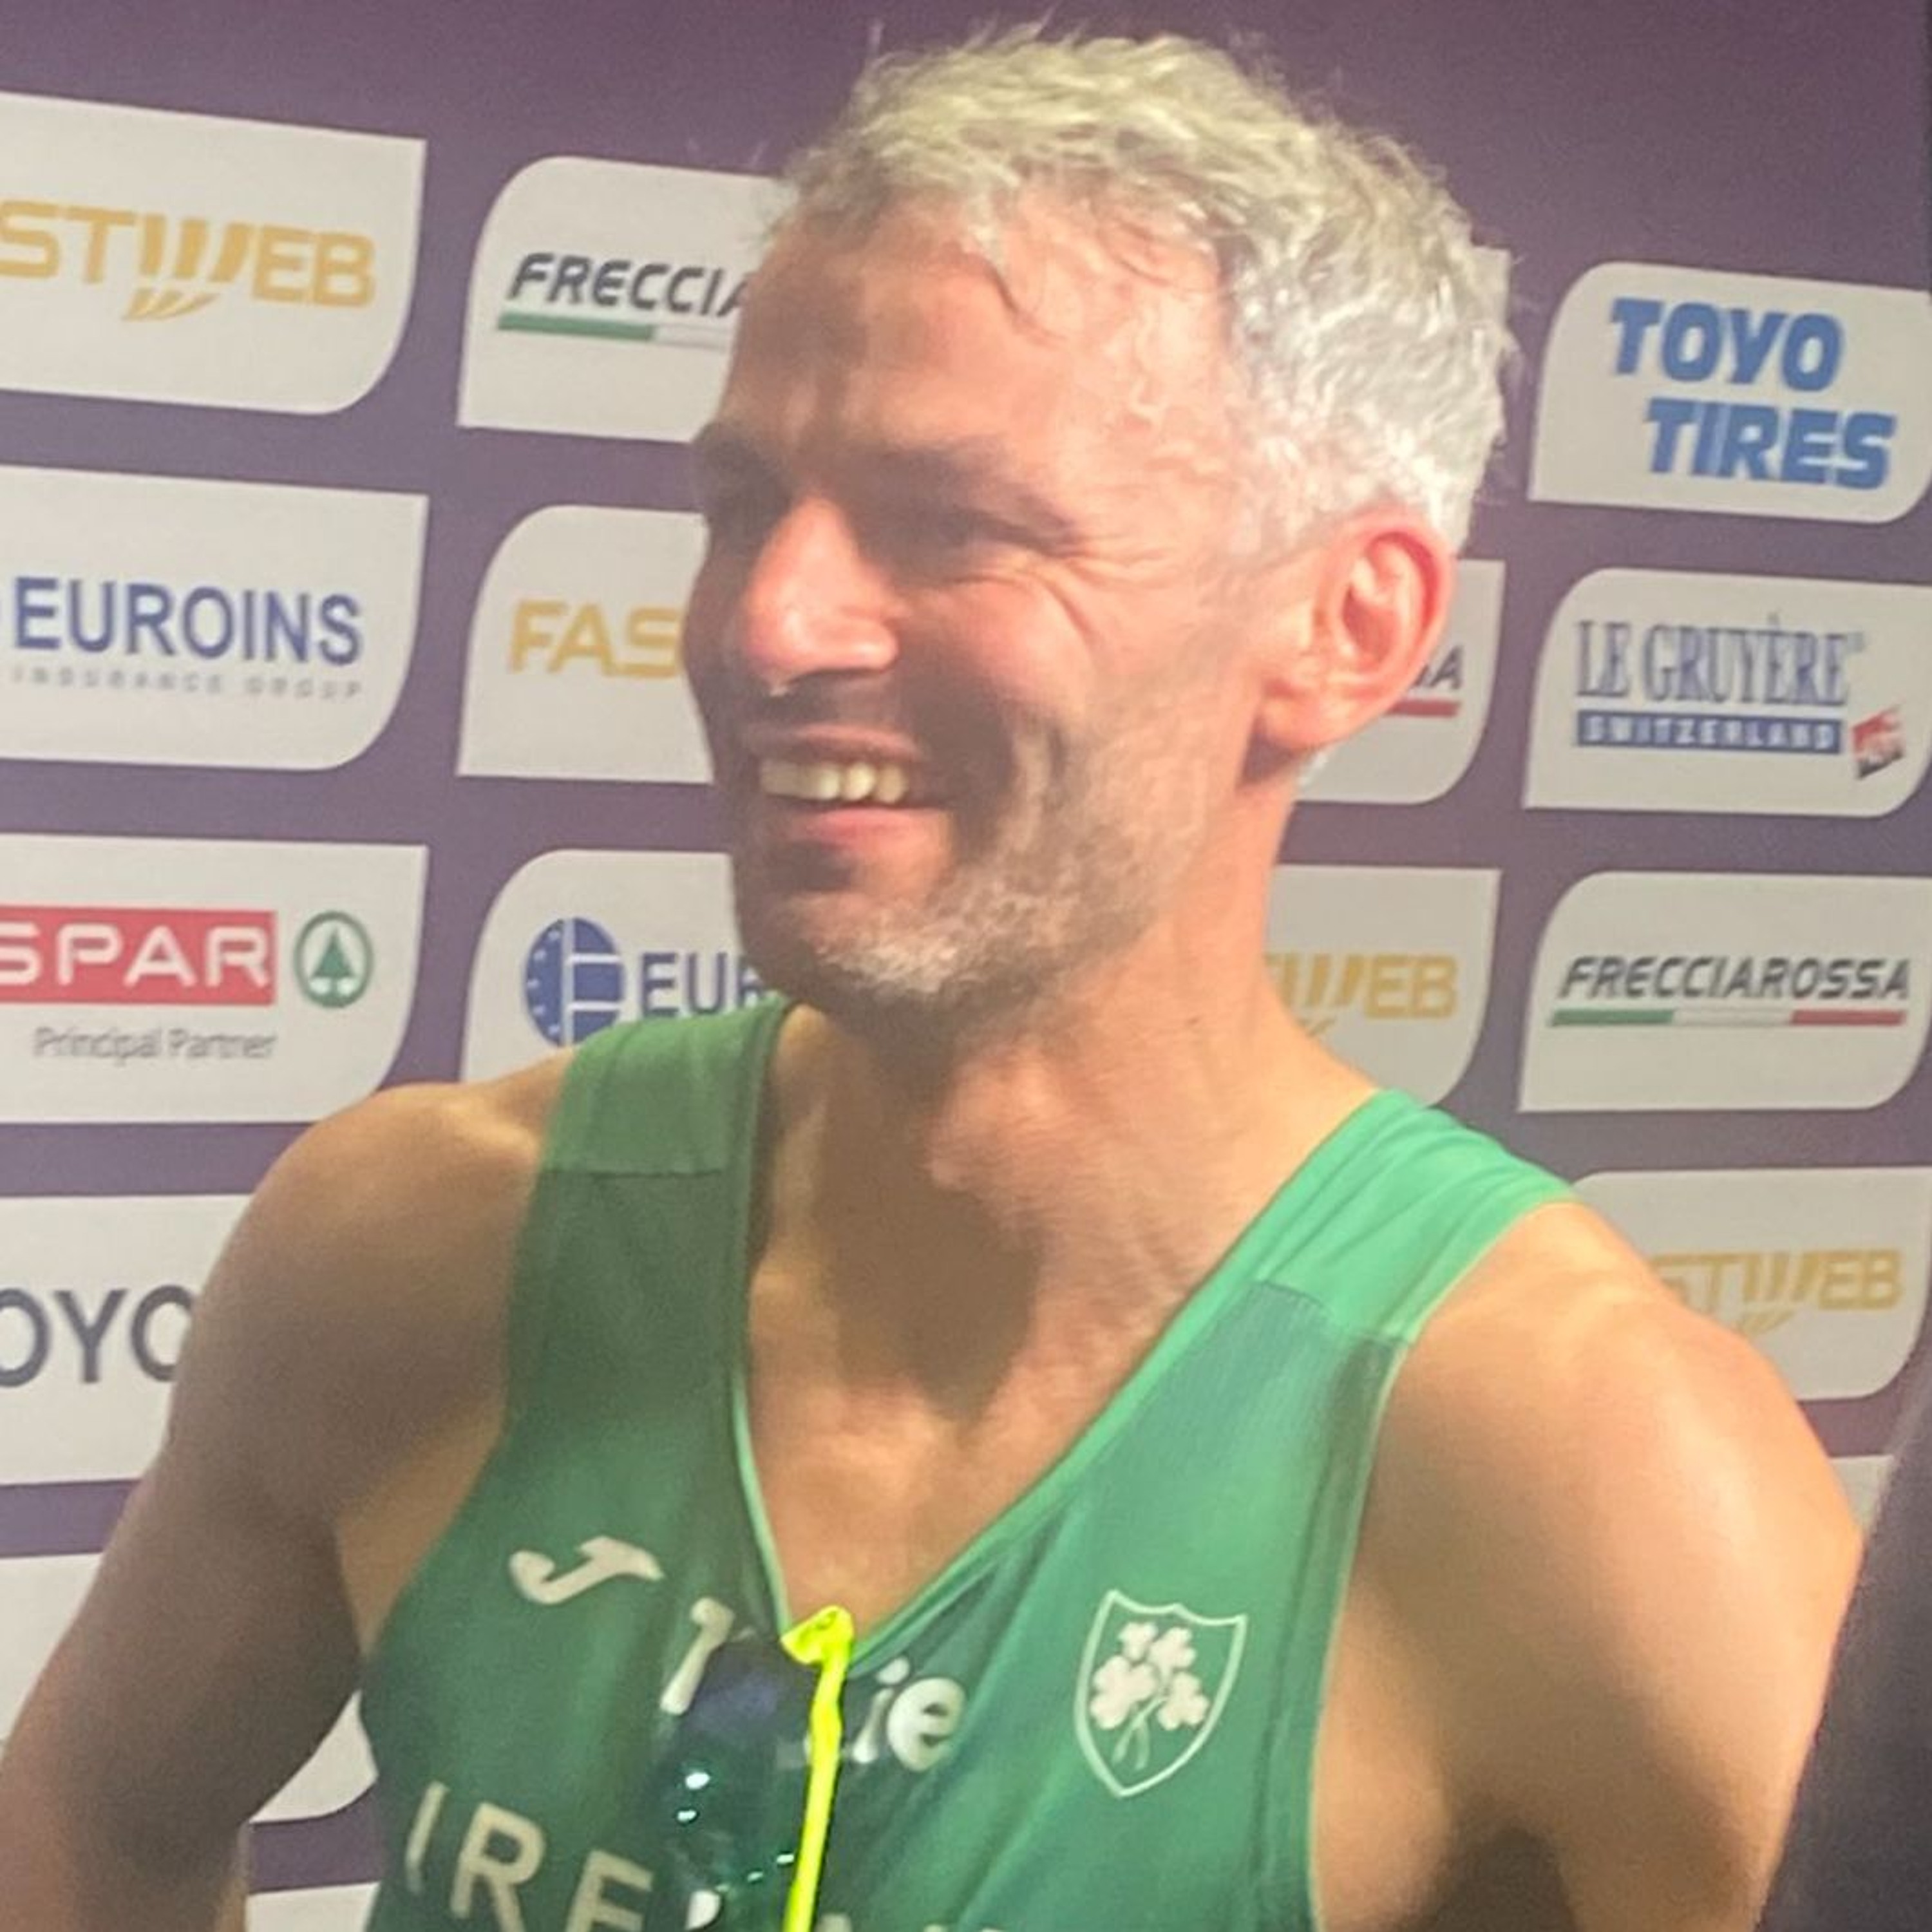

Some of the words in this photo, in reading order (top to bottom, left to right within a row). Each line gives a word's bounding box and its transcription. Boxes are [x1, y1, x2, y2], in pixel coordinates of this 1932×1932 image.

[1611, 297, 1843, 392] TOYO
[1645, 397, 1897, 490] TIRES
[14, 576, 362, 665] EUROINS
[1577, 621, 1631, 697] LE
[1643, 612, 1846, 706] GRUYÈRE
[1582, 714, 1838, 750] SWITZERLAND
[0, 921, 270, 987] SPAR
[1265, 952, 1458, 1037] WEB
[1557, 957, 1910, 999] FRECCIAROSSA
[34, 1027, 161, 1066] Principal
[168, 1028, 277, 1059] Partner
[0, 1285, 193, 1387] OYO
